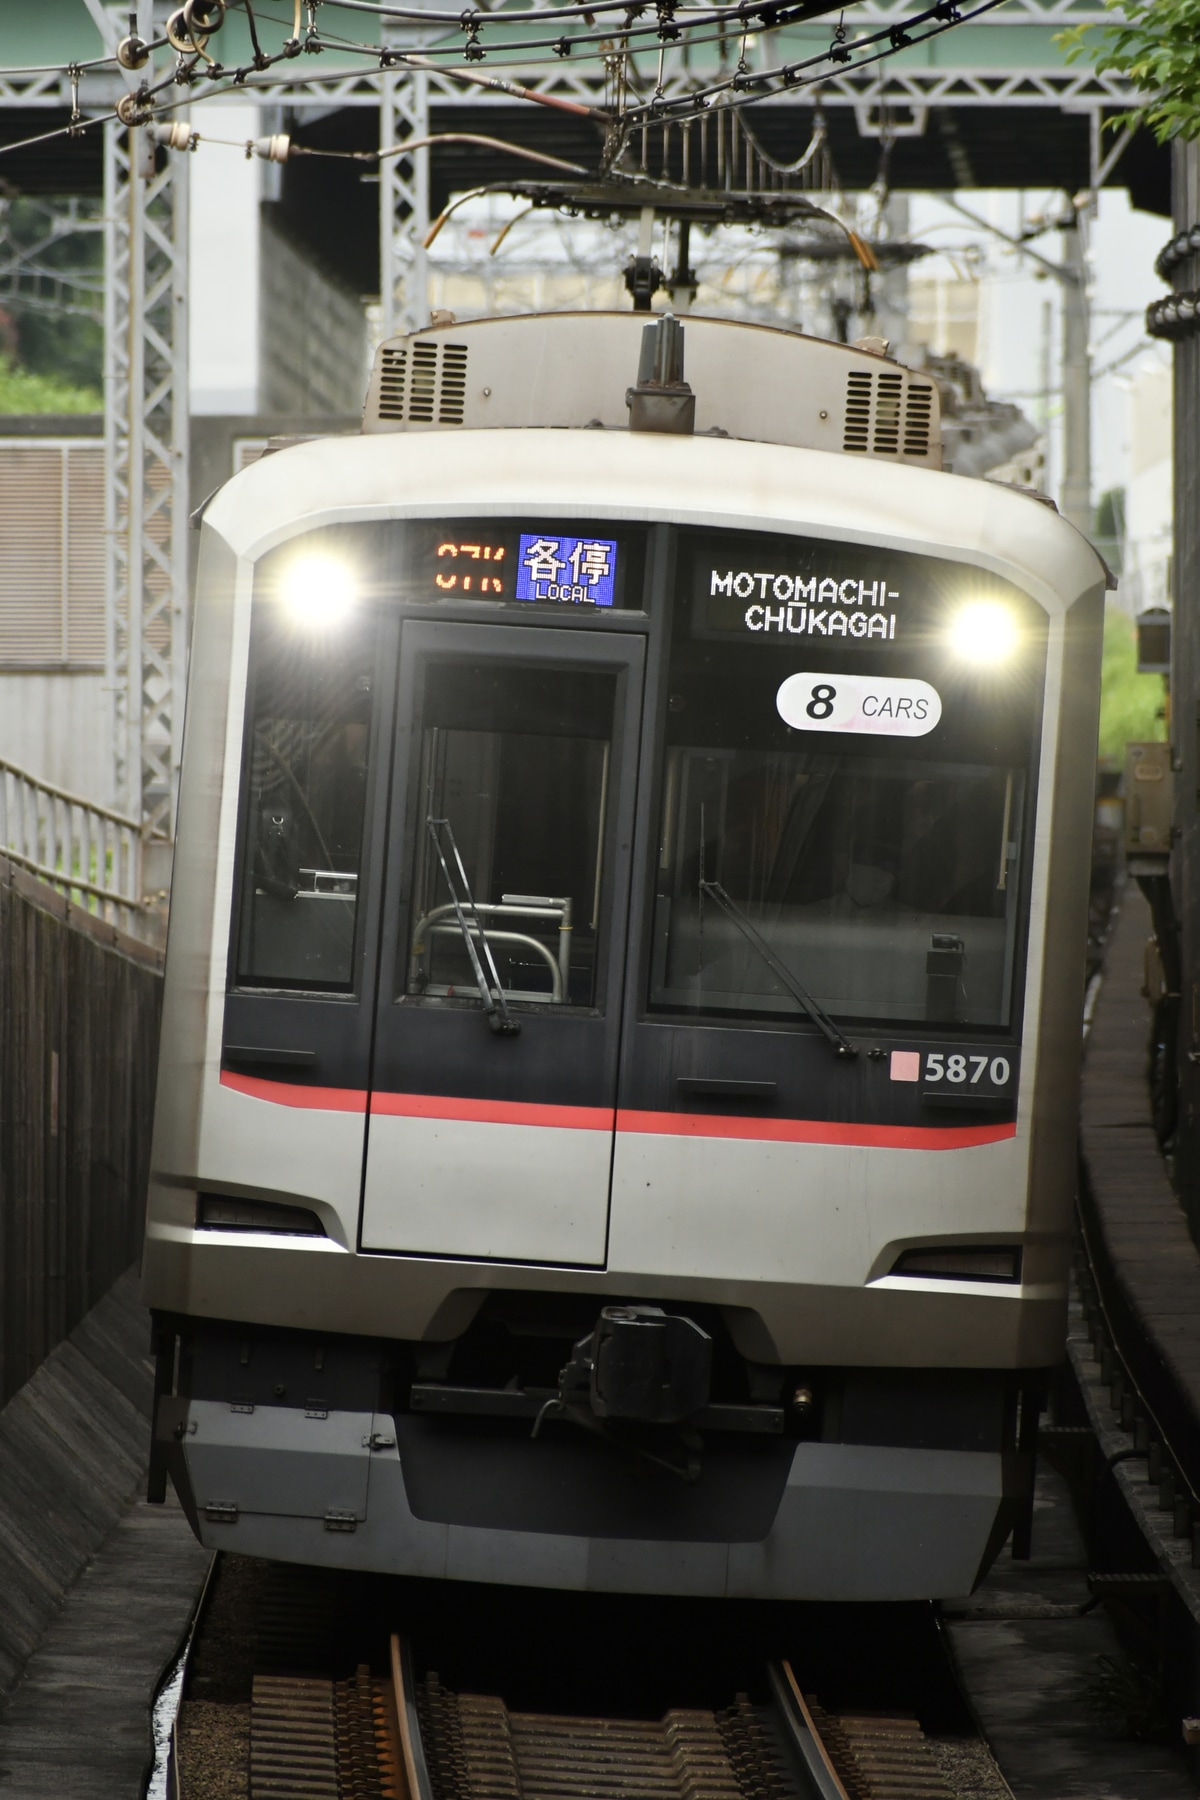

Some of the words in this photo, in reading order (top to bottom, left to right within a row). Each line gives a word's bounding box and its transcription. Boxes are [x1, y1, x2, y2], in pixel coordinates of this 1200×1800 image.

[523, 538, 611, 585] 各停
[535, 582, 596, 603] LOCAL
[710, 570, 900, 607] MOTOMACHI-
[745, 601, 897, 640] CHŪKAGAI
[806, 684, 837, 720] 8
[861, 695, 929, 720] CARS
[924, 1053, 1010, 1085] 5870
